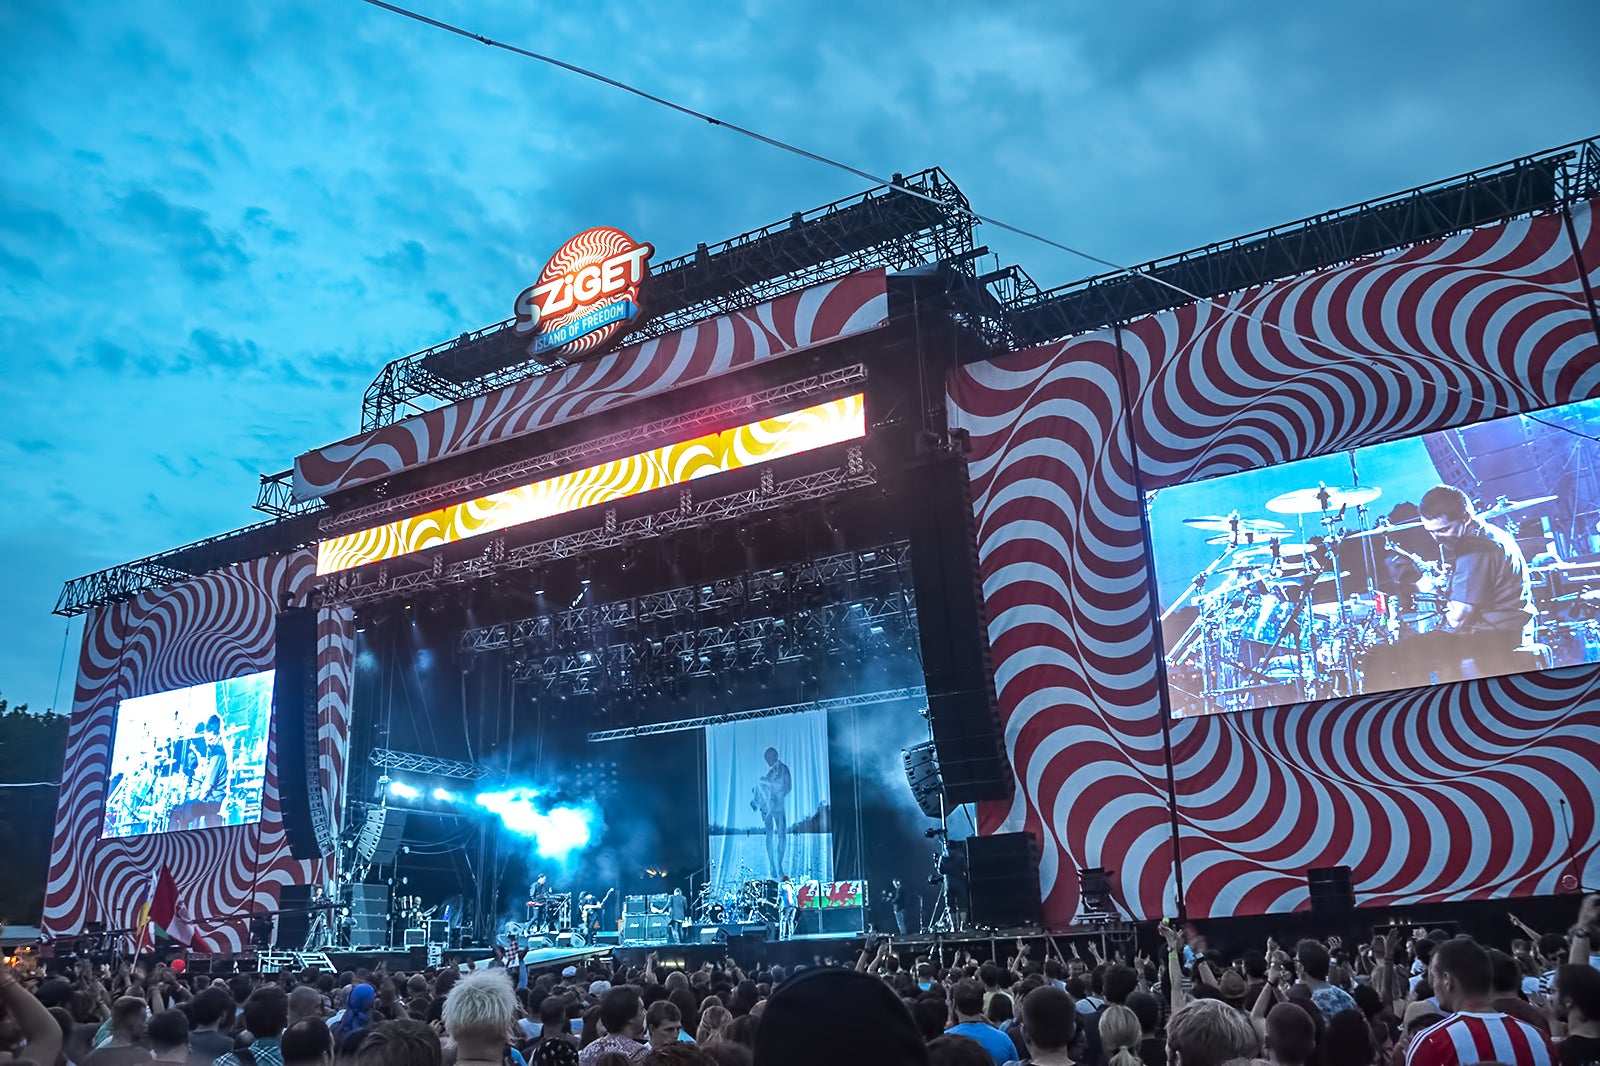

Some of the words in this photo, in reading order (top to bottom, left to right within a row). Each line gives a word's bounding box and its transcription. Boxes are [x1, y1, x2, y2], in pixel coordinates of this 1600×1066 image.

[534, 329, 567, 351] ISLAND
[569, 320, 580, 336] OF
[582, 303, 624, 331] FREEDOM
